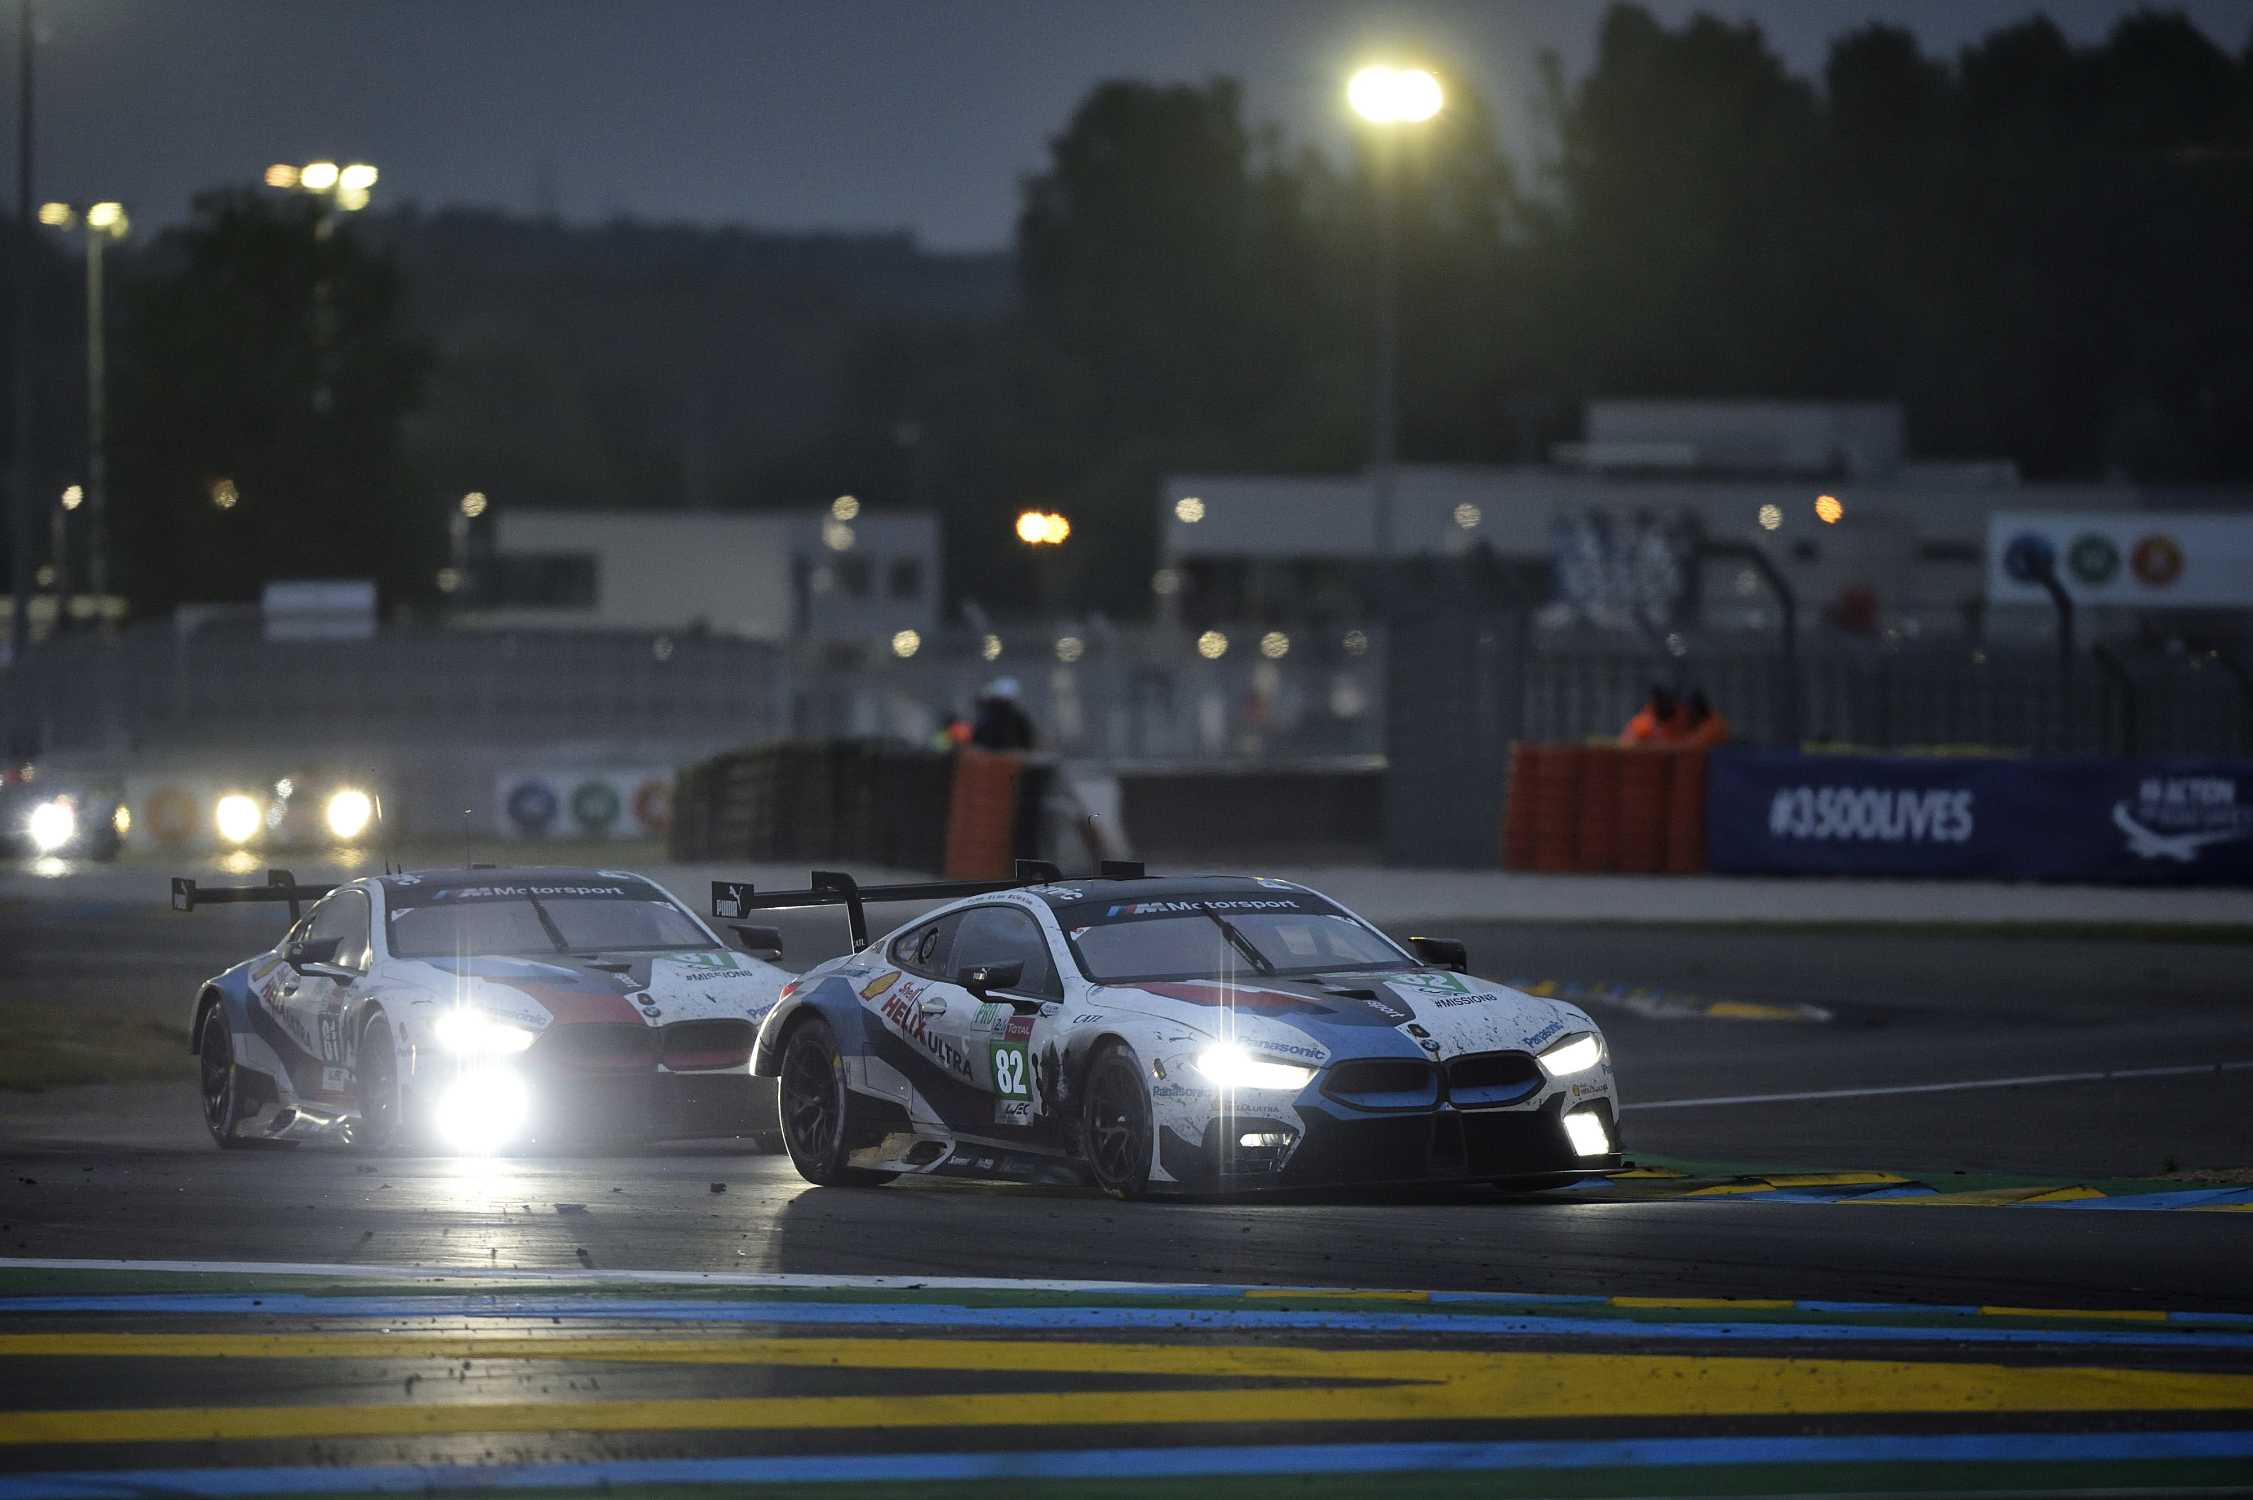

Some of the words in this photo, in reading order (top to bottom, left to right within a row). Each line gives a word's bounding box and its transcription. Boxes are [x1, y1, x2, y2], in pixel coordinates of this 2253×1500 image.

[1769, 786, 1973, 840] #3500LIVES
[1166, 899, 1300, 912] Motorsport
[881, 993, 927, 1040] HELIX
[928, 1031, 974, 1081] ULTRA
[1008, 1023, 1031, 1035] TOTAL
[1240, 1036, 1326, 1060] Panasonic
[995, 1048, 1027, 1094] 82
